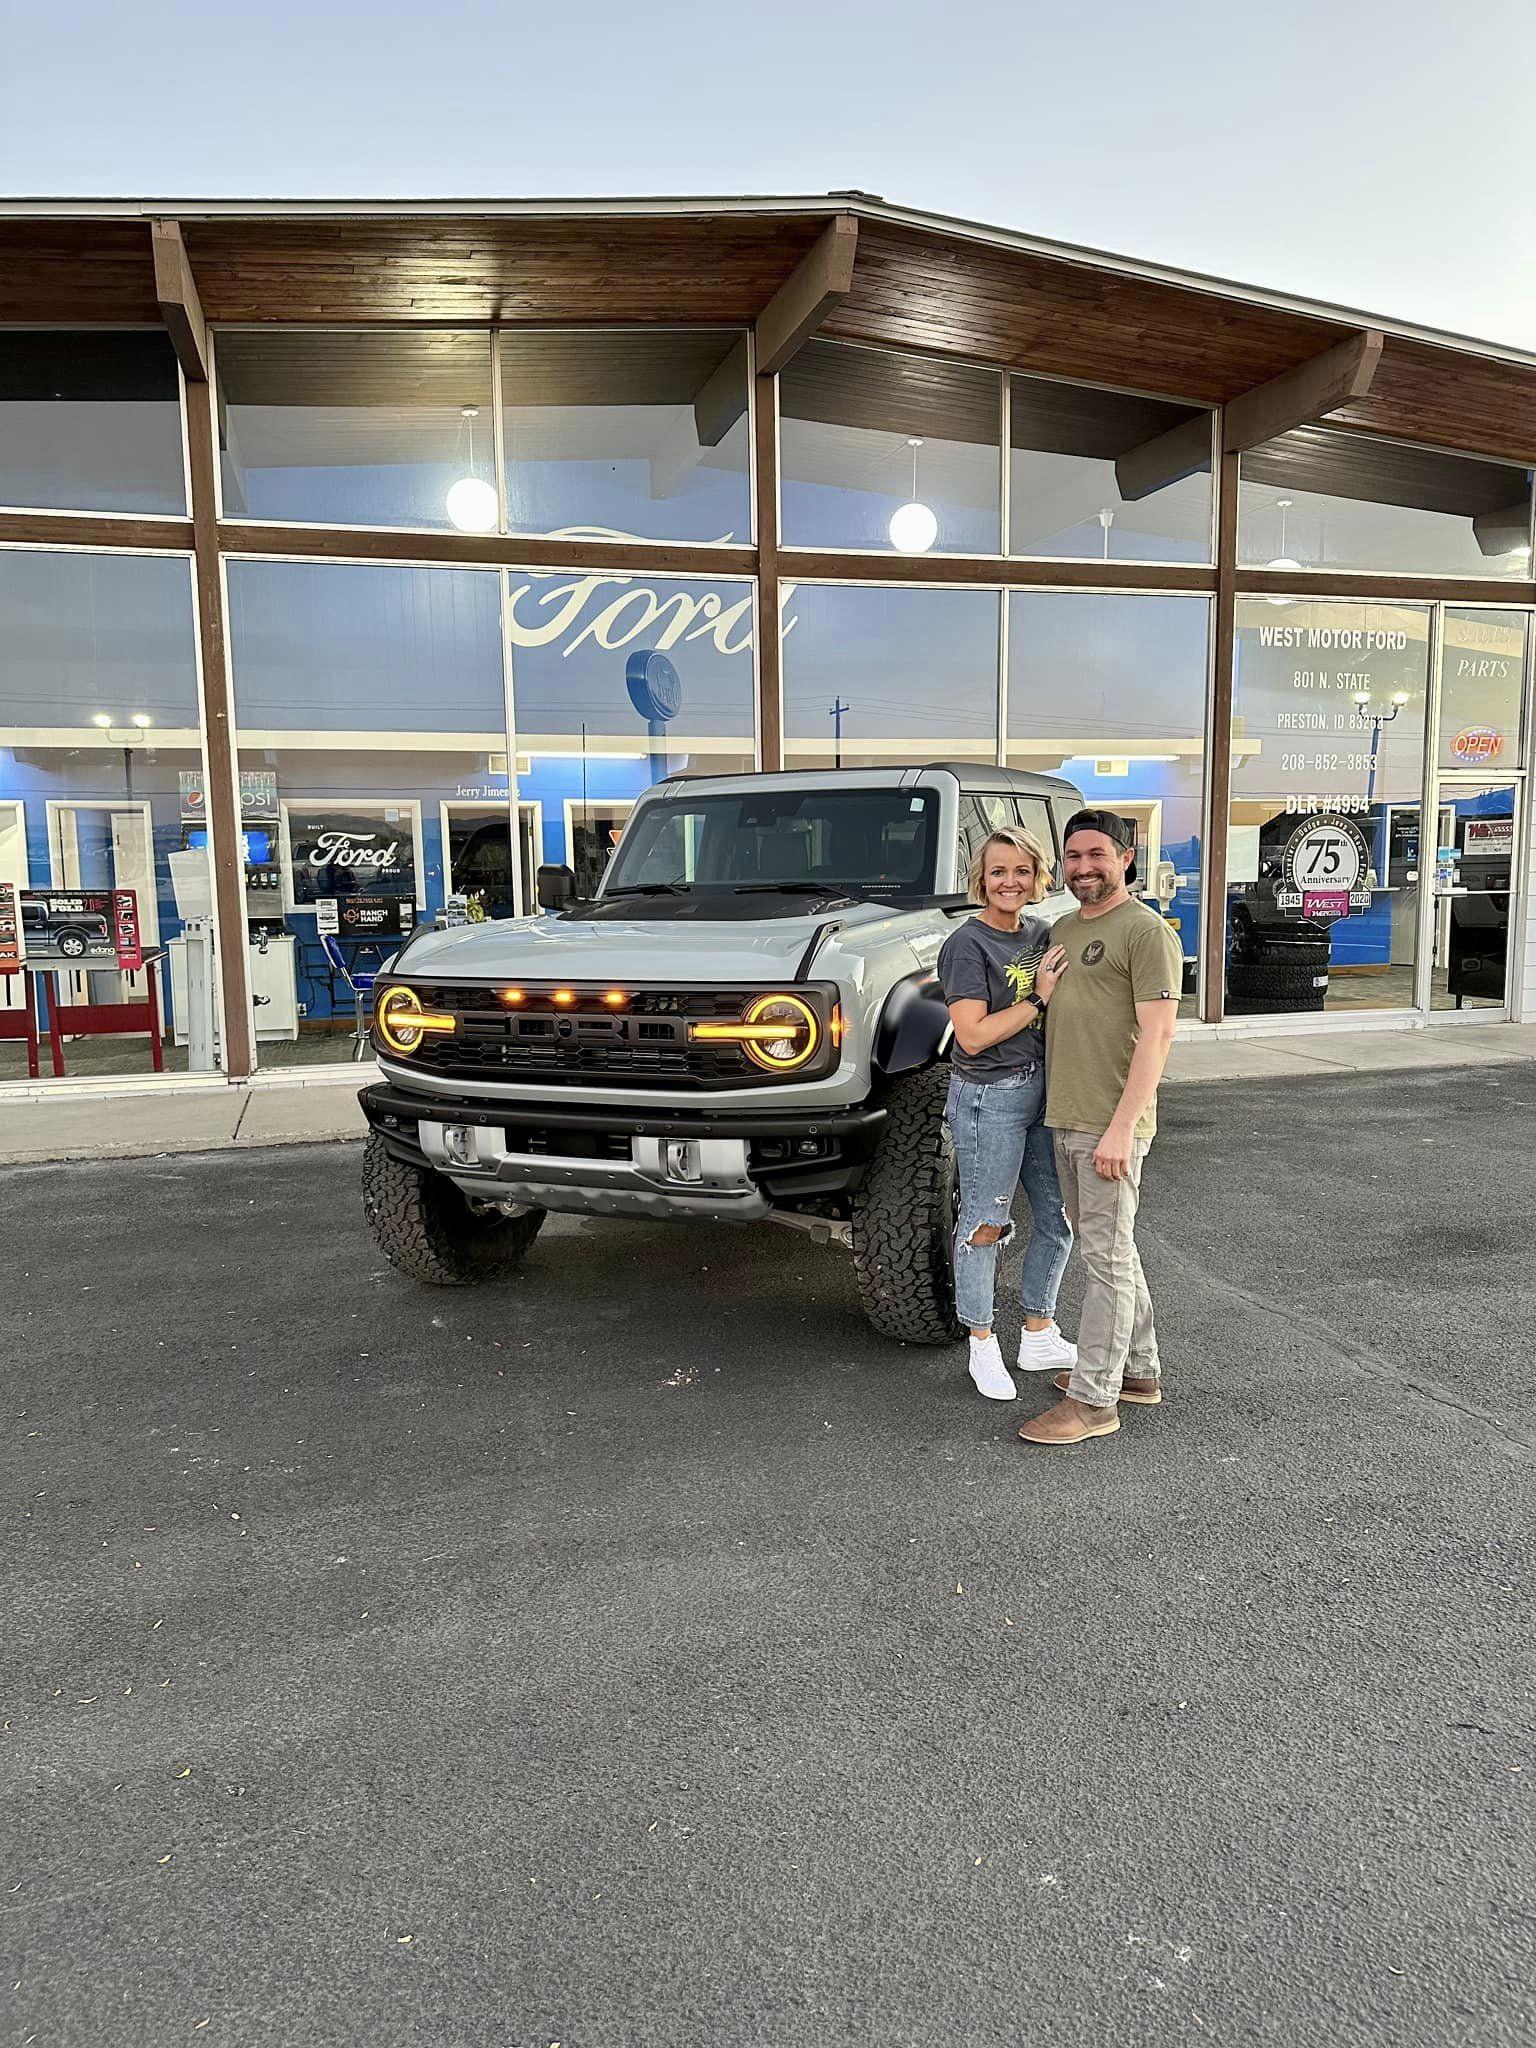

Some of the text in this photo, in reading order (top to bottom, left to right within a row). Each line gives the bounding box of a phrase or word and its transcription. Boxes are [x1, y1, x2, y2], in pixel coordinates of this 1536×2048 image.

[1259, 626, 1406, 650] WEST MOTOR FORD
[1457, 659, 1510, 678] PARTS
[1293, 671, 1370, 690] 801 N. STATE
[1277, 713, 1329, 730] PRESTON,
[1334, 714, 1344, 729] ID
[1455, 735, 1502, 755] OPEN
[1281, 753, 1378, 771] 208-852-3853
[456, 784, 480, 799] Jerry
[1285, 794, 1370, 815] DLR #4994
[309, 831, 398, 867] Ford
[1301, 875, 1351, 884] Anniversary
[1280, 895, 1300, 906] 1945
[1350, 893, 1369, 904] 2020
